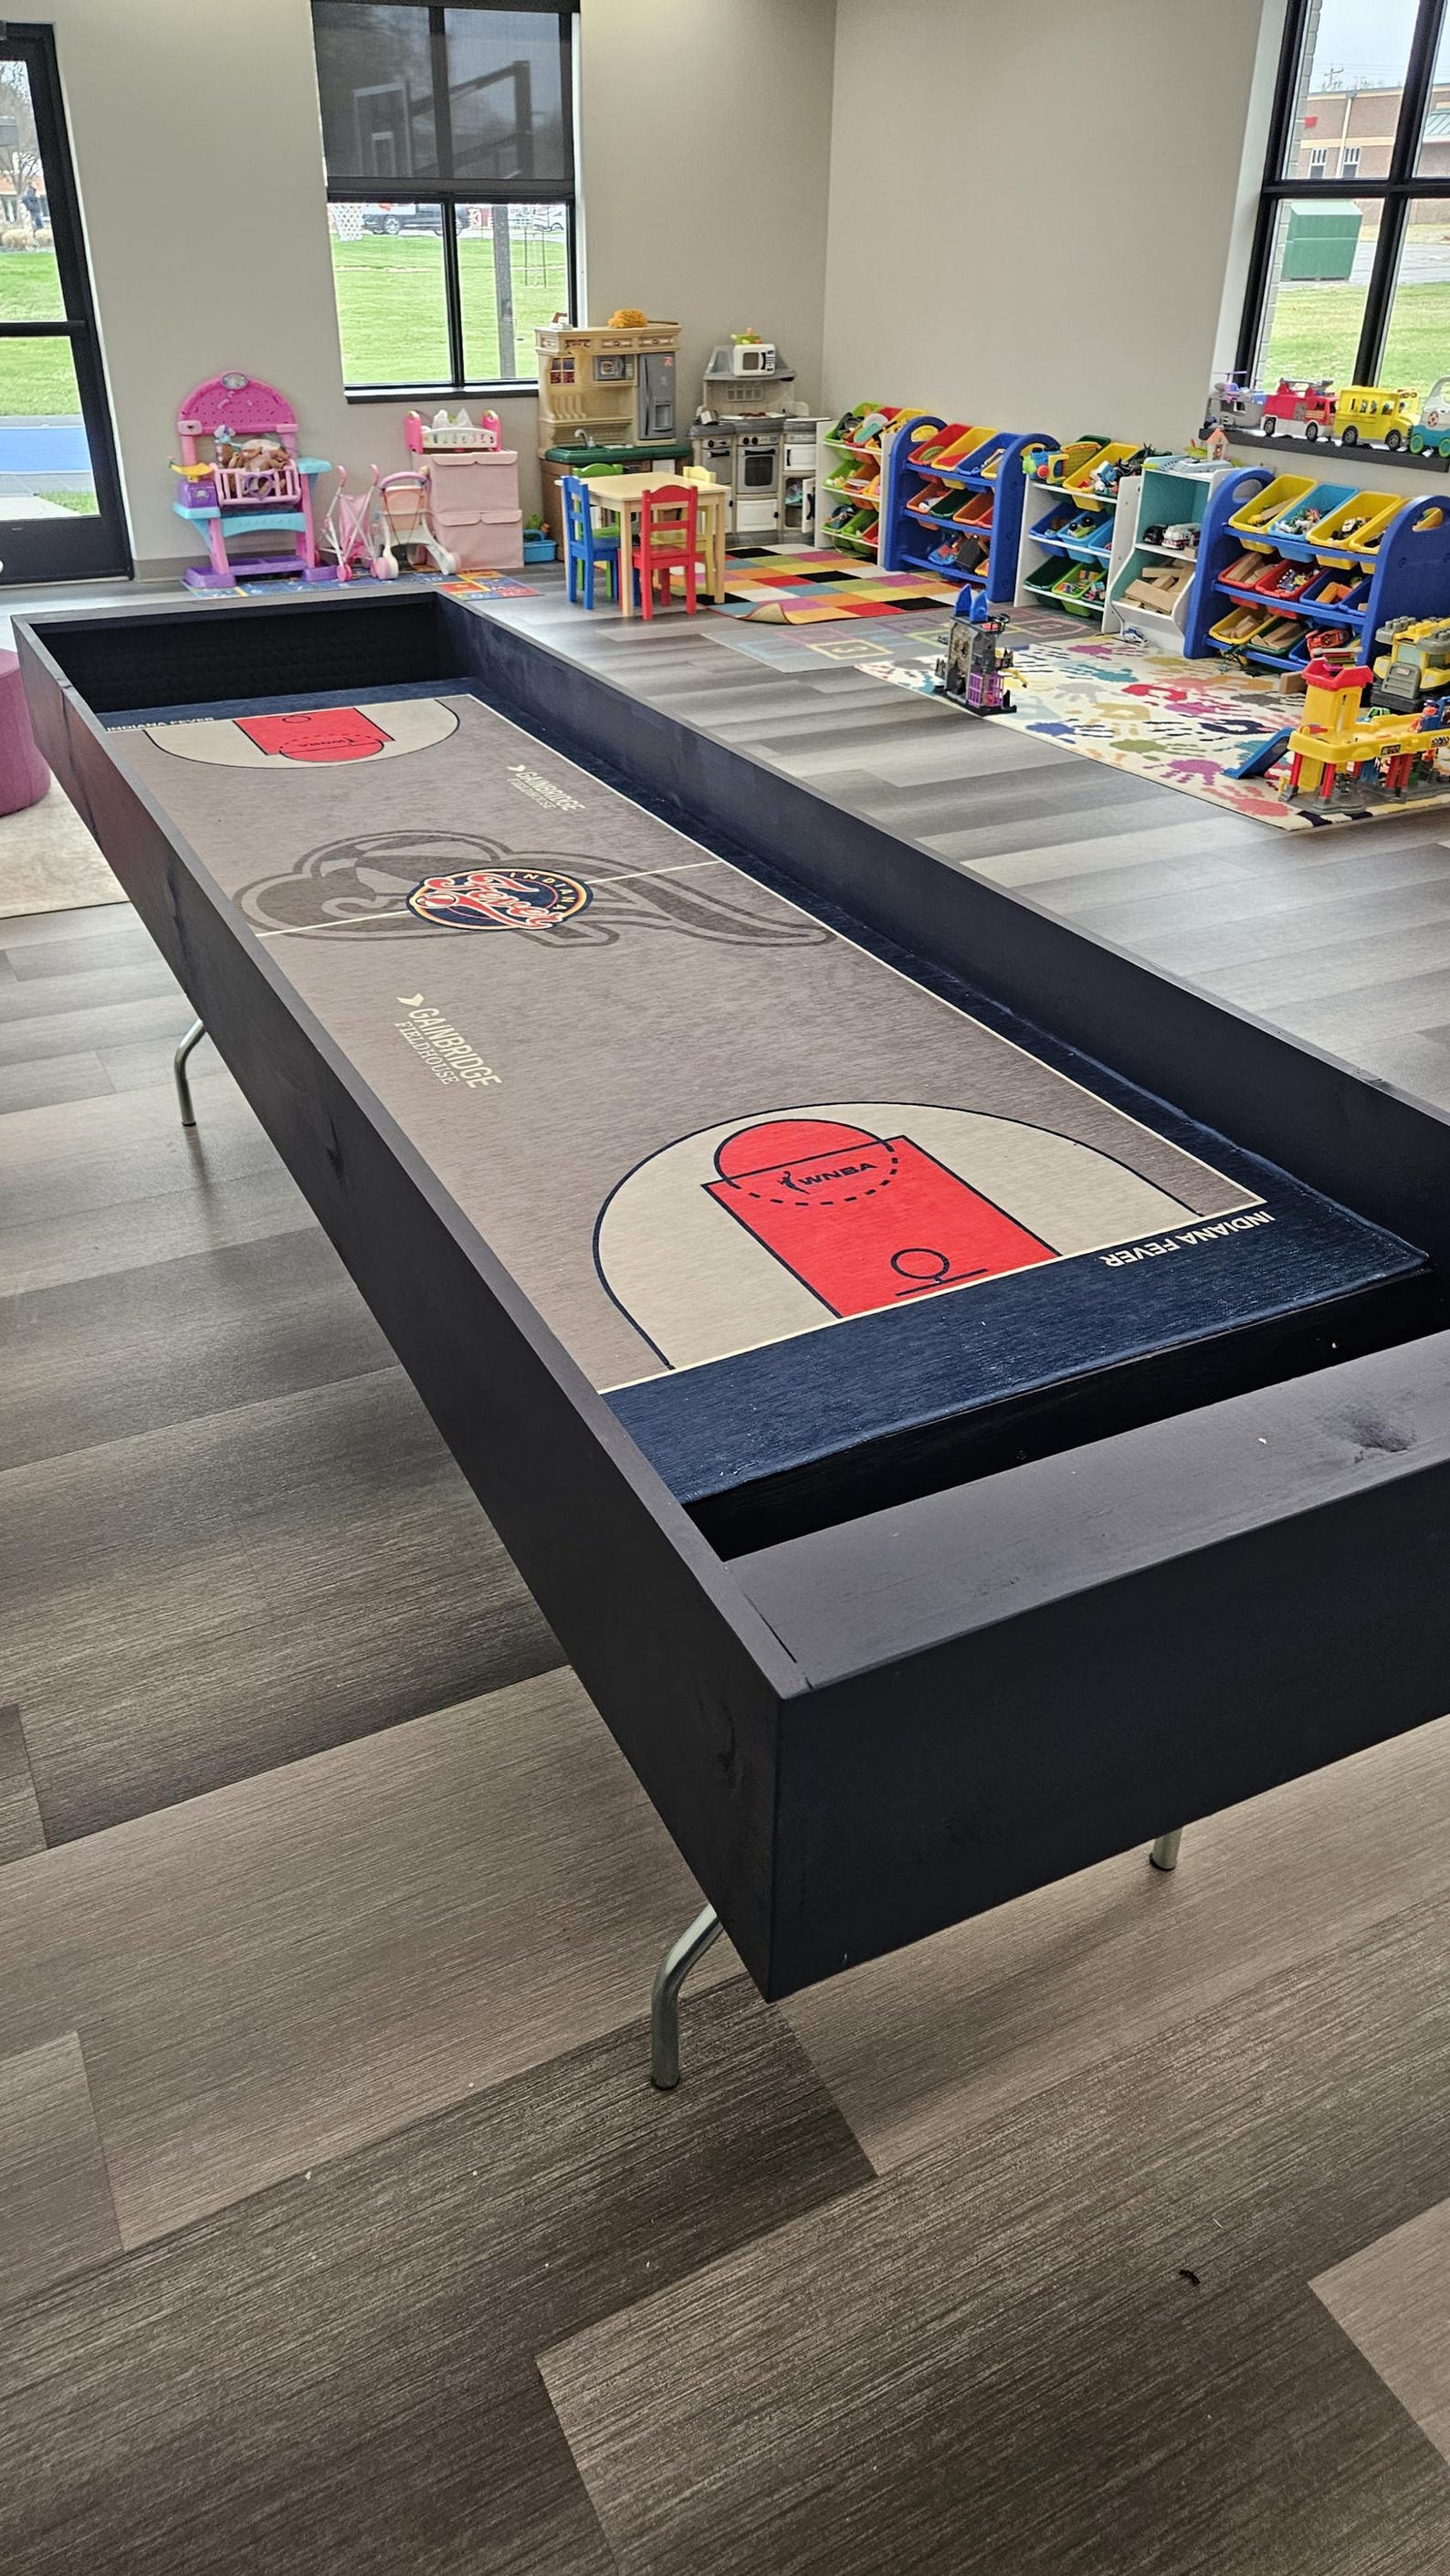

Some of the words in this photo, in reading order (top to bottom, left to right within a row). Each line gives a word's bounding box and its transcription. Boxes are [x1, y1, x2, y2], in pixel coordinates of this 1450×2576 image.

[515, 772, 586, 811] GAINBRIDGE
[424, 873, 564, 930] Fever
[510, 872, 575, 910] INDIANA
[394, 1021, 460, 1085] FIELDHOUSE
[408, 1007, 503, 1088] GAINBRIDGE
[797, 1162, 878, 1185] WNBA
[1175, 1211, 1277, 1245] INDIANA
[1099, 1238, 1182, 1267] FEVER
